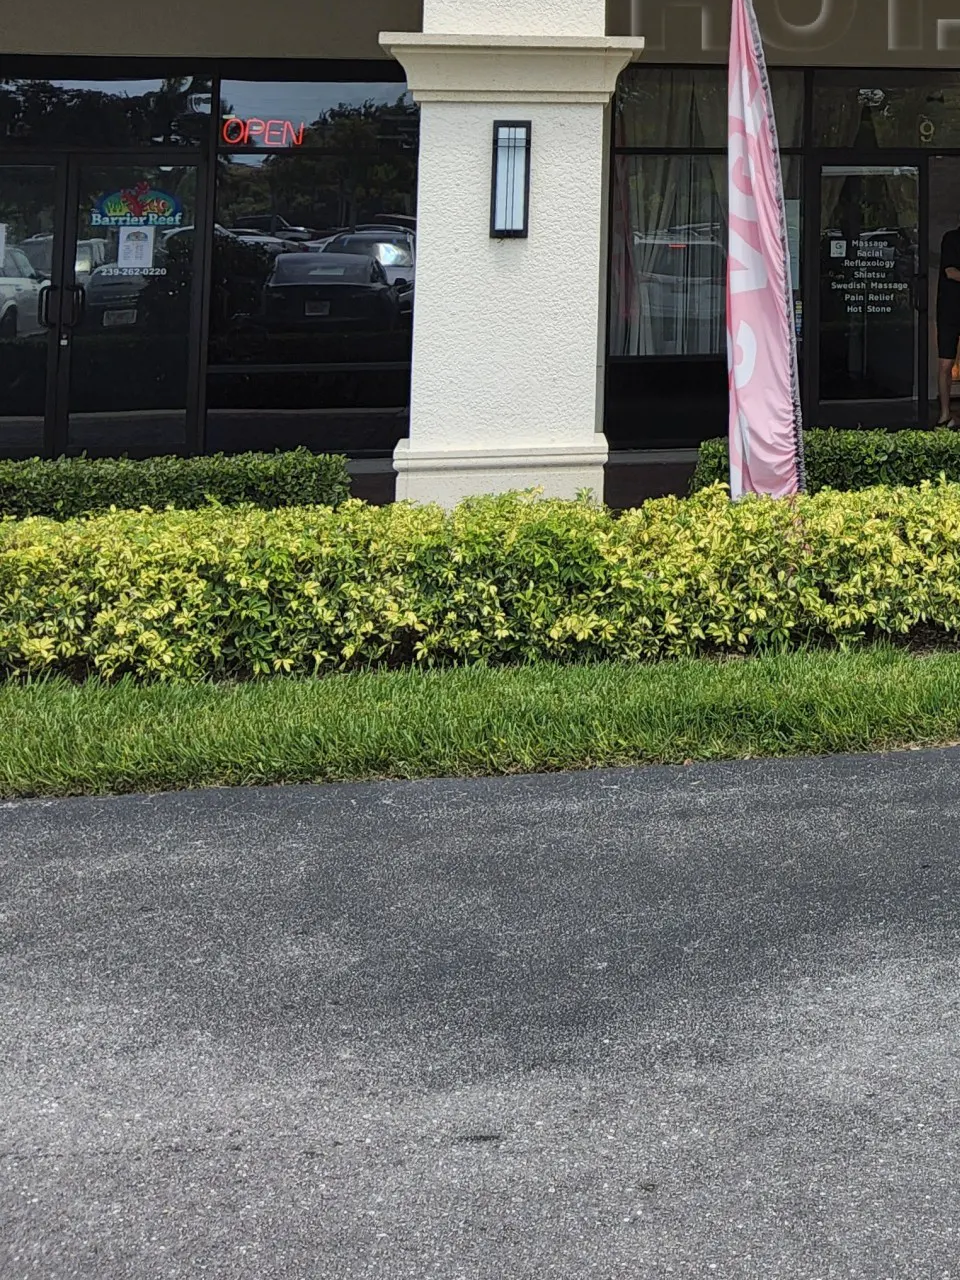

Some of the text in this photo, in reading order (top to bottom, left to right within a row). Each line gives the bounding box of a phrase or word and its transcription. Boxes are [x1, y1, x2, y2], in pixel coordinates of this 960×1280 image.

[222, 117, 306, 147] OPEN
[919, 120, 935, 142] 9
[91, 212, 182, 226] Barrier Reef
[852, 239, 888, 248] Massage
[844, 260, 895, 269] Reflexology
[101, 267, 167, 276] 239-262-0220
[854, 271, 886, 279] Shiatsu
[870, 282, 908, 291] Massage
[844, 293, 894, 301] Pain Relief
[847, 305, 892, 313] Hot Stone
